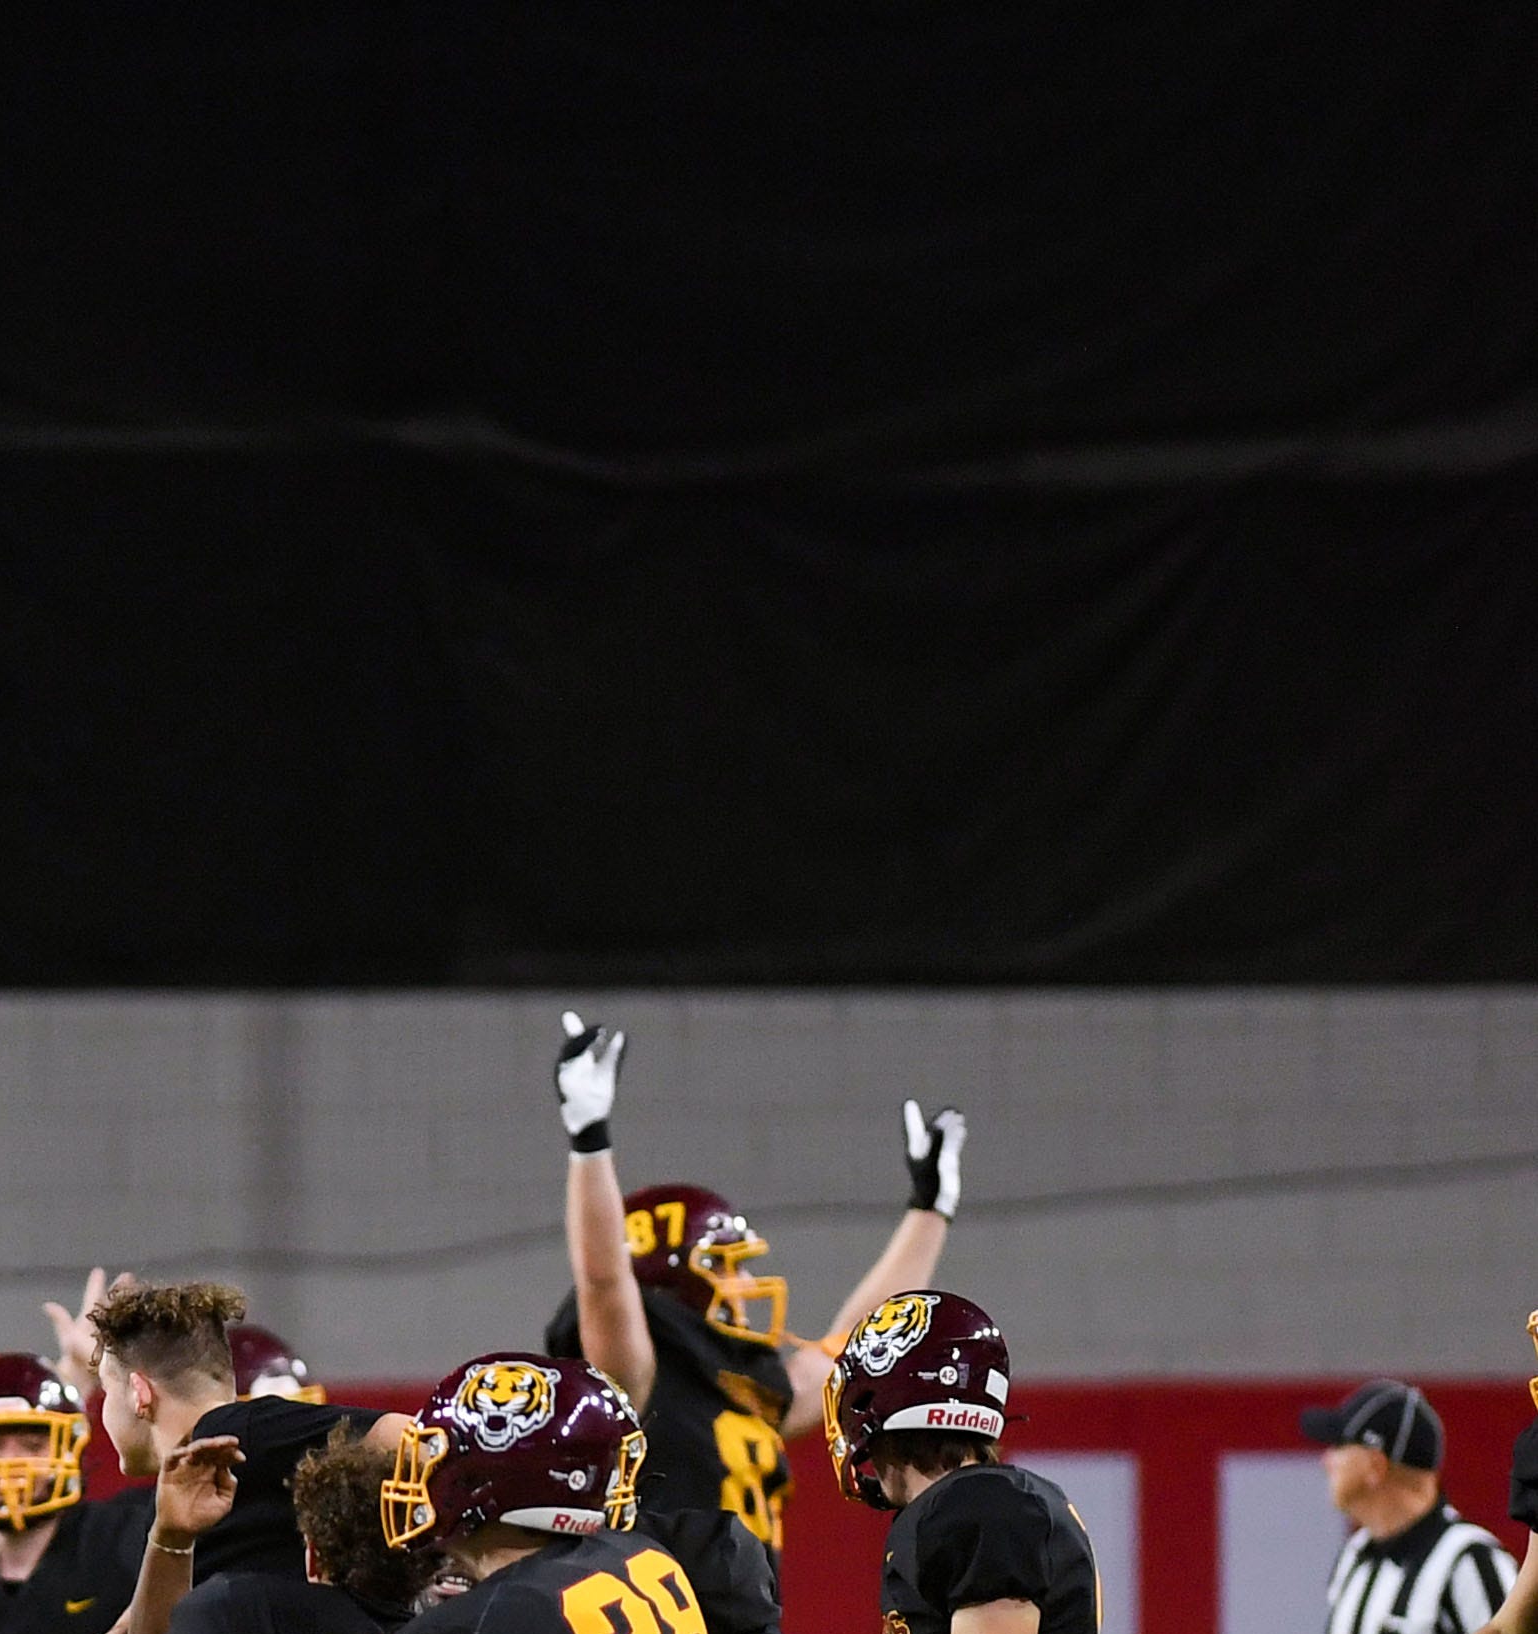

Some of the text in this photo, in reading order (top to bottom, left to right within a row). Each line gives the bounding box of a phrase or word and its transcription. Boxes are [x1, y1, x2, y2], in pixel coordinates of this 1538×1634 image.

[625, 1202, 686, 1256] 87
[941, 1370, 956, 1383] 42
[927, 1409, 999, 1433] Riddell
